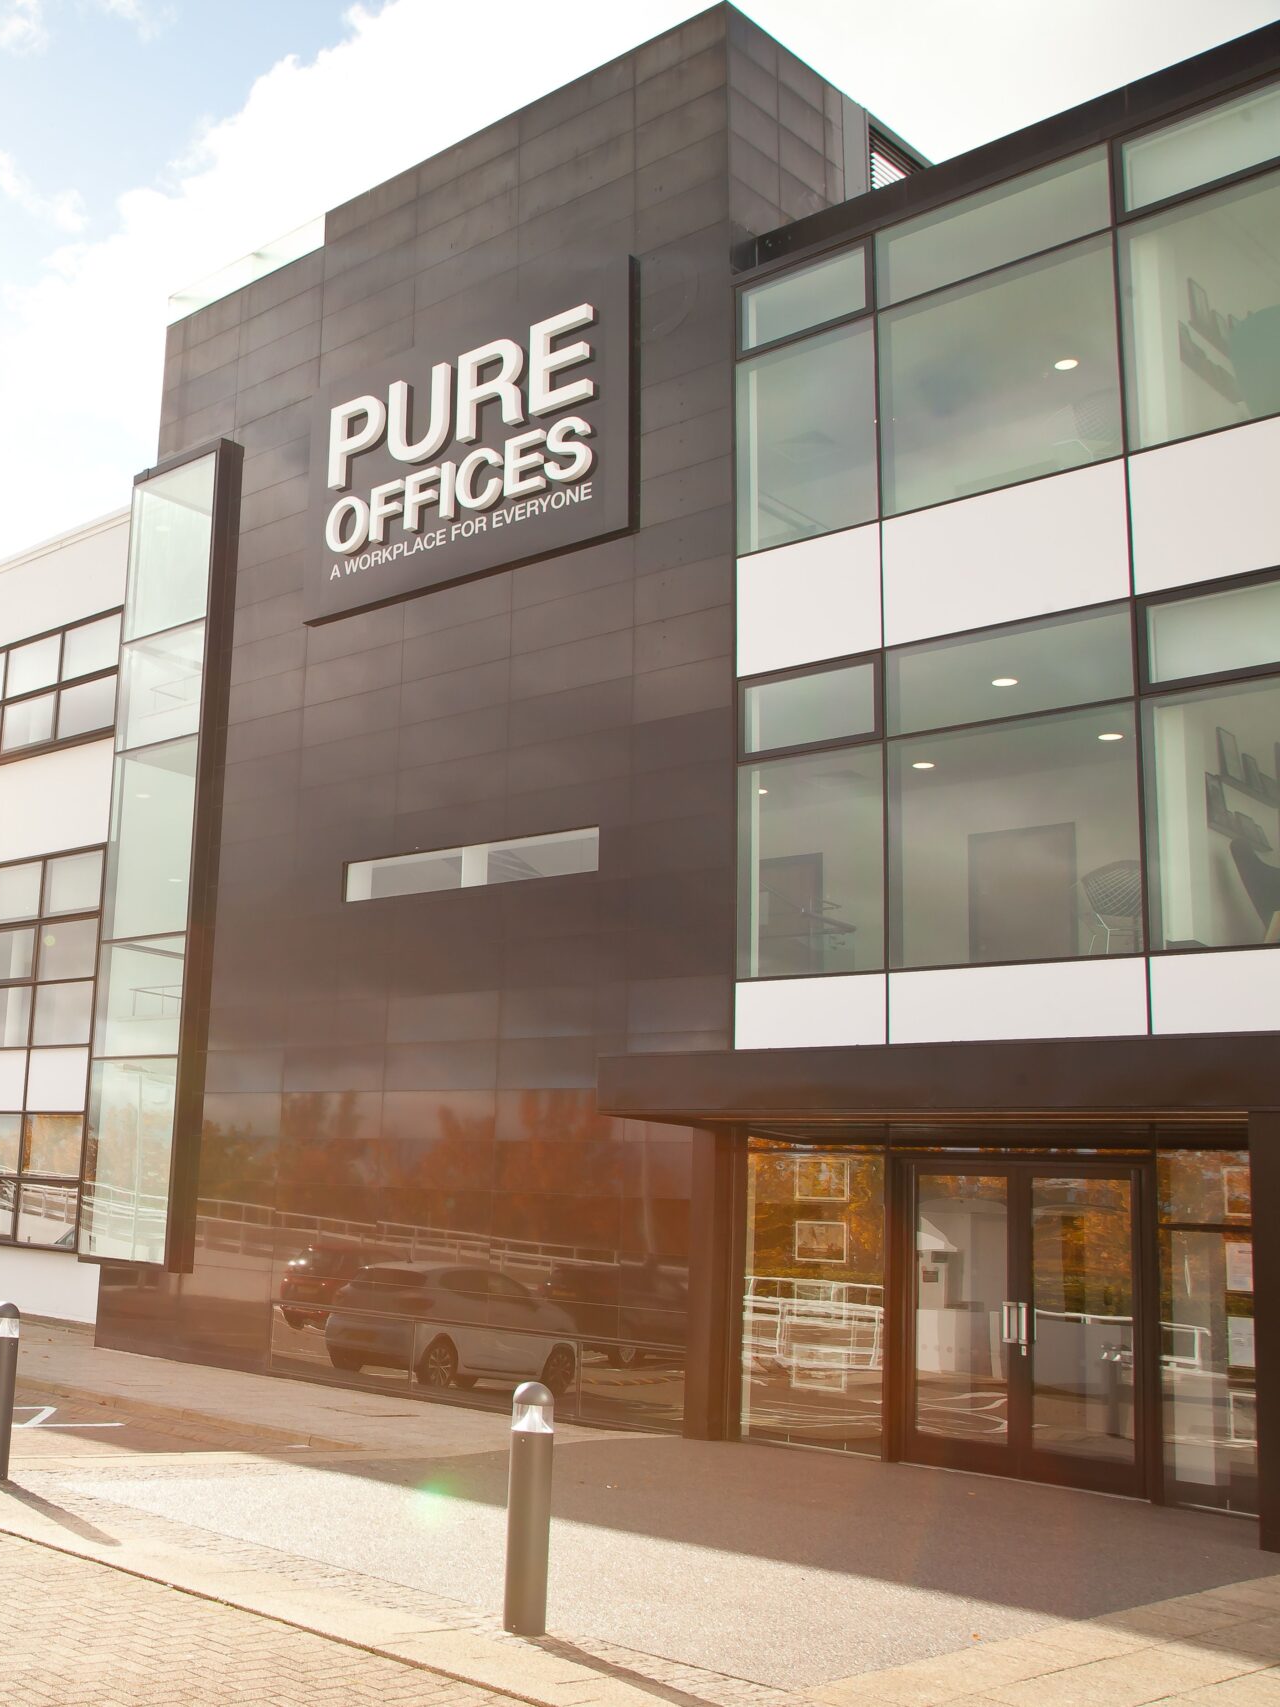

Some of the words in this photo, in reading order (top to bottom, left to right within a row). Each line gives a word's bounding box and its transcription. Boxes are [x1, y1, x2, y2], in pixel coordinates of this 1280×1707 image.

[327, 302, 595, 491] PURE
[325, 415, 594, 555] OFFICES
[329, 563, 341, 581] A
[344, 528, 447, 575] WORKPLACE
[450, 516, 487, 542] FOR
[491, 482, 593, 529] EVERYONE
